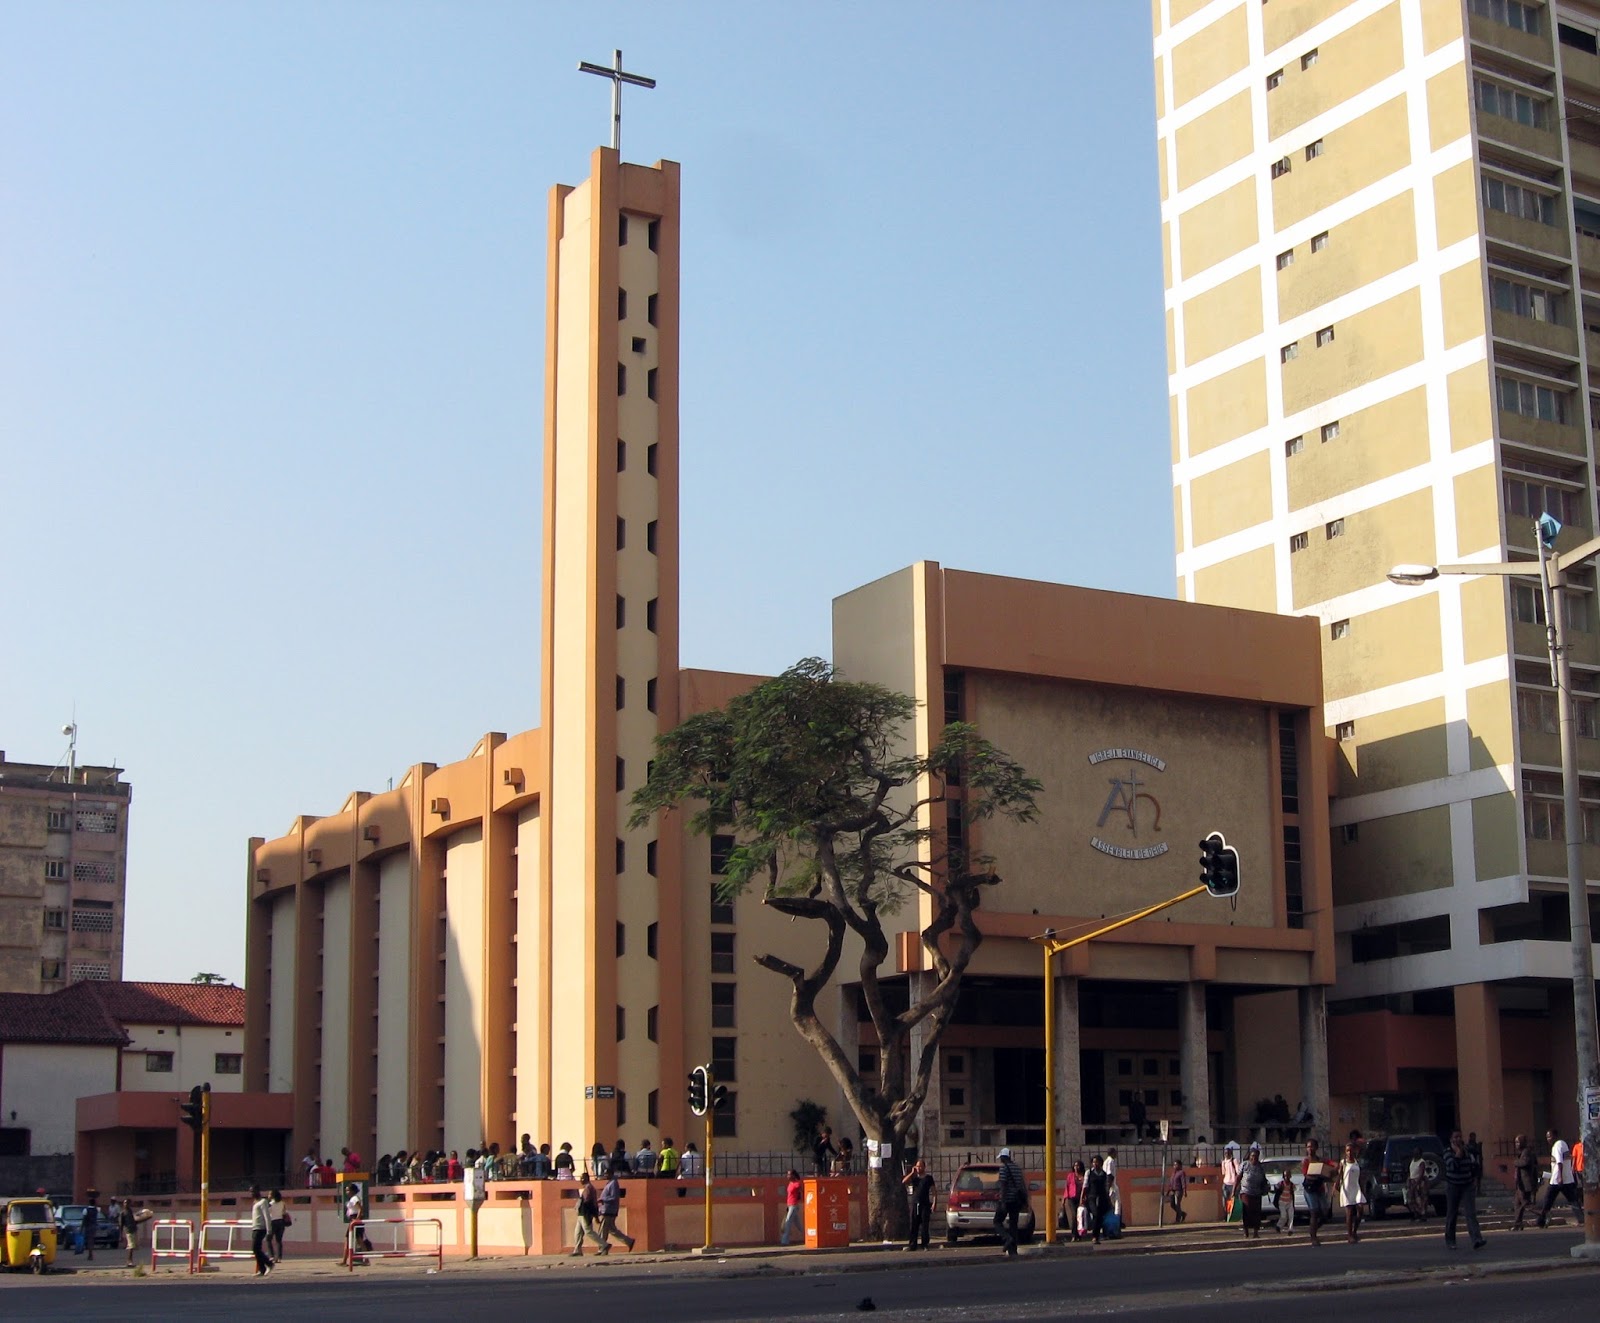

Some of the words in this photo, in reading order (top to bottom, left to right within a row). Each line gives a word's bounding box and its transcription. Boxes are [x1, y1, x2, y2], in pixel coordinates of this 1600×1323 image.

[1095, 749, 1119, 761] IGREJA
[1095, 841, 1136, 858] ASSEMBLEIA
[1137, 849, 1147, 858] DE
[1148, 843, 1165, 857] DEUS
